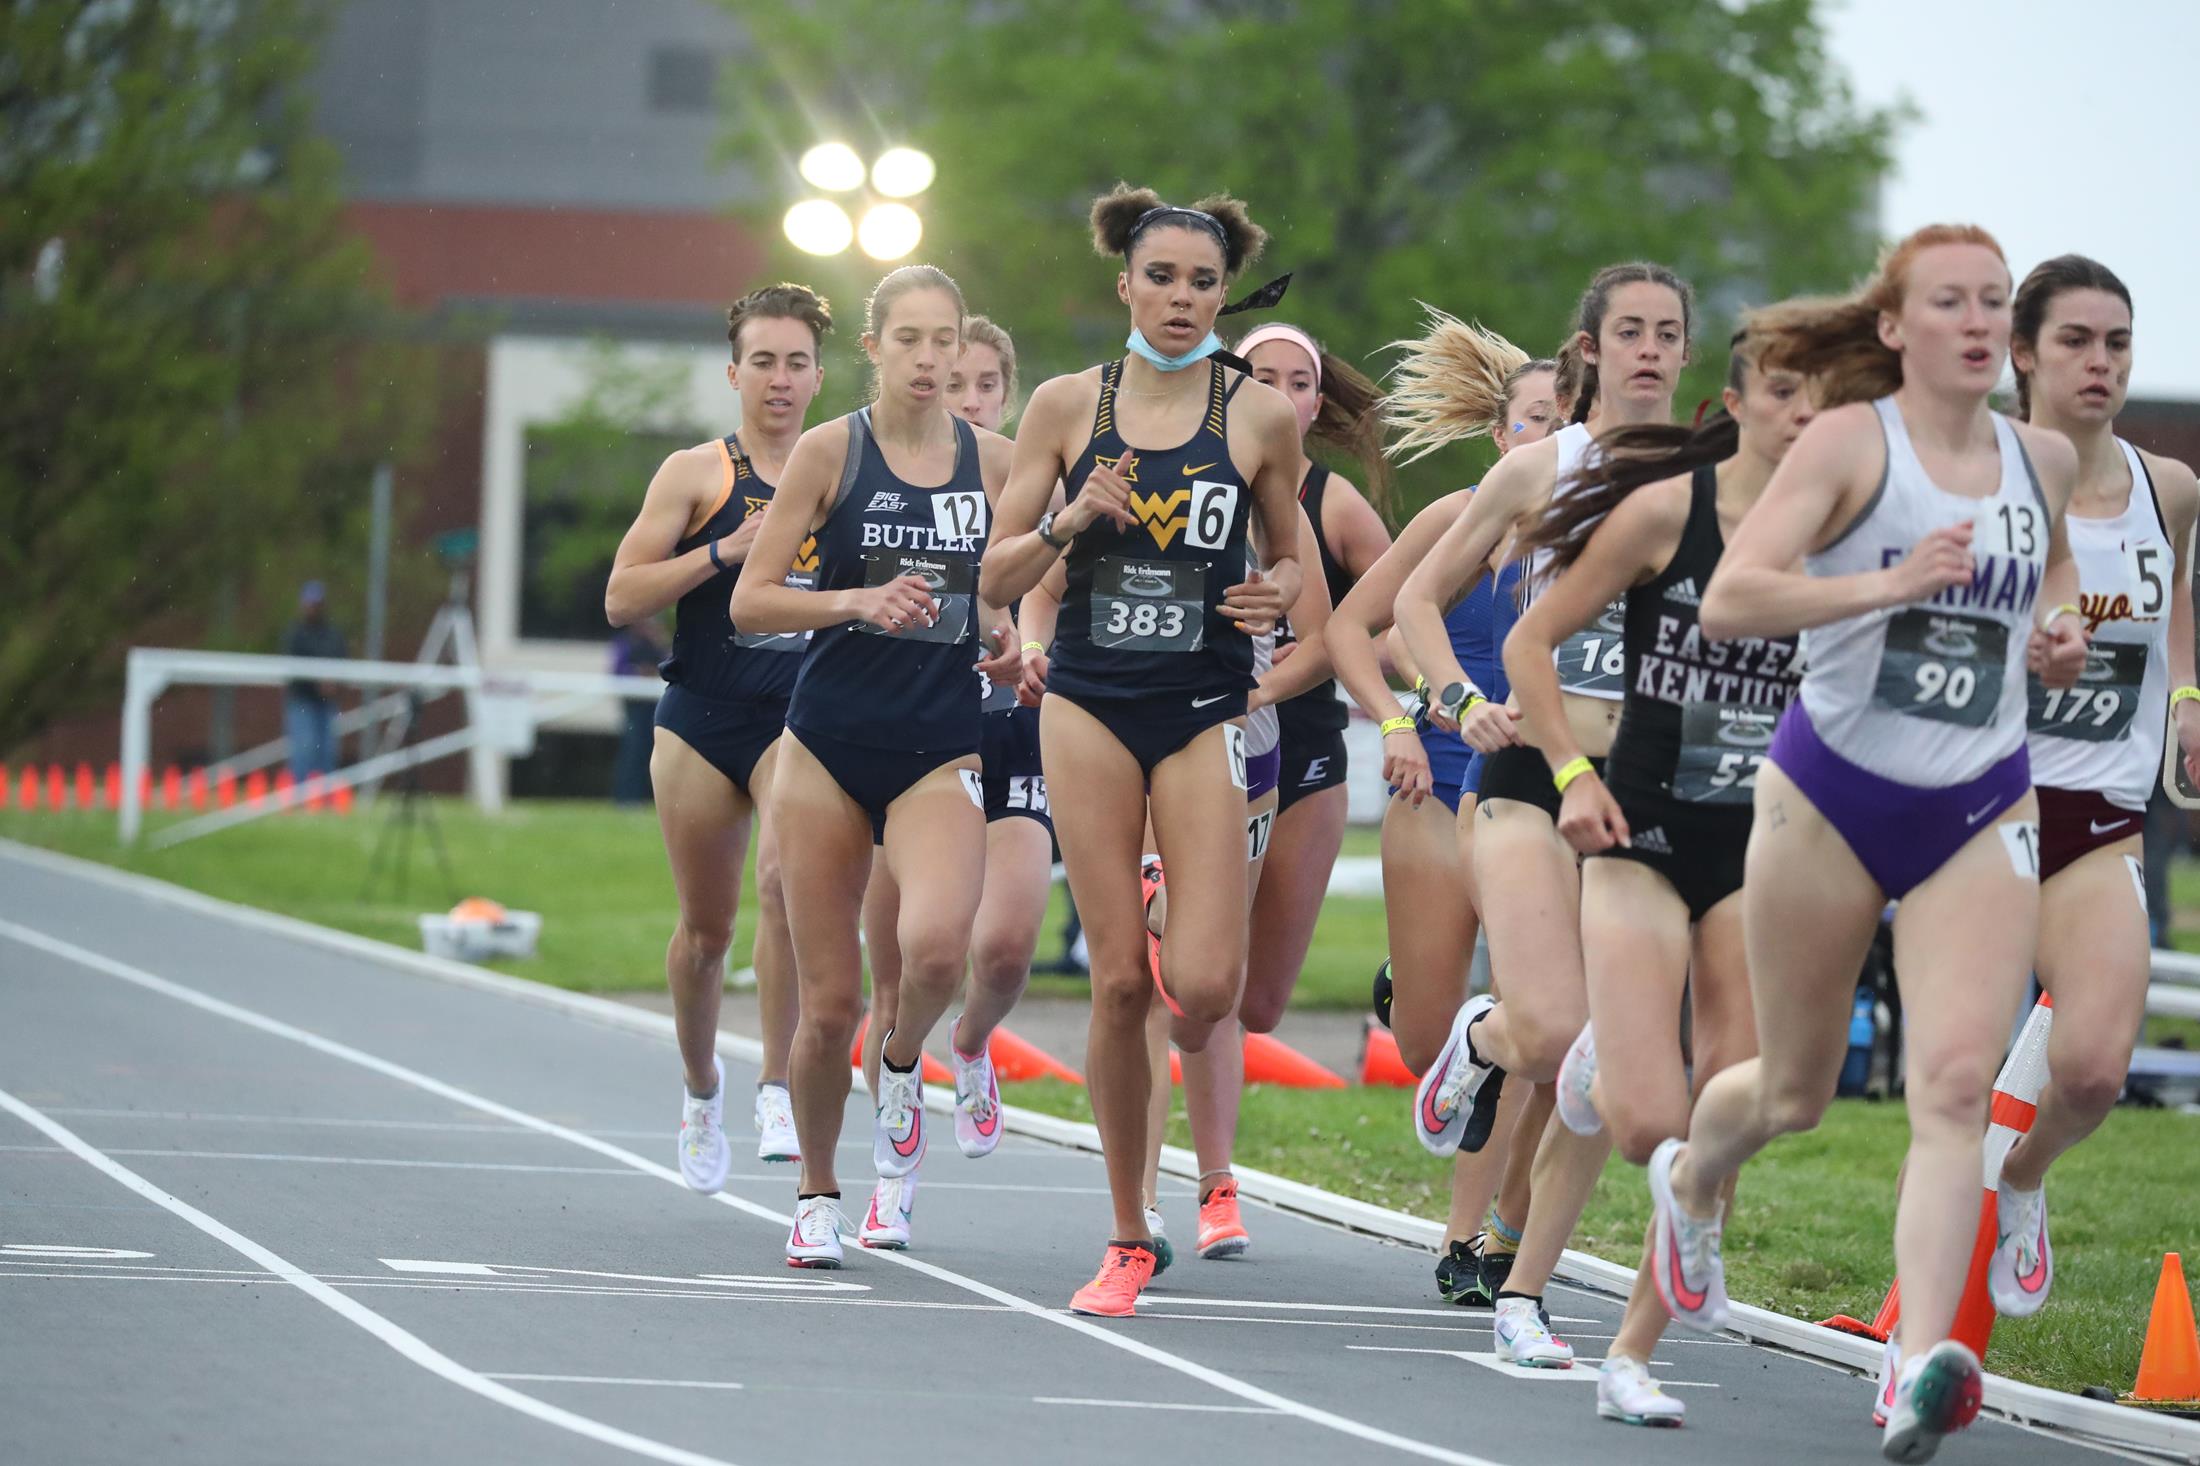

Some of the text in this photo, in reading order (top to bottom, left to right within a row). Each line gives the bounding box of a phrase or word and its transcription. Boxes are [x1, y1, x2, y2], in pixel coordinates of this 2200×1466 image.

[868, 500, 909, 511] EAST
[873, 491, 902, 501] BIG
[943, 494, 980, 536] 12
[1197, 486, 1228, 545] 6
[1998, 504, 2036, 556] 13
[2136, 549, 2164, 613] 5
[1106, 601, 1186, 638] 383
[1654, 615, 1799, 679] EASTE
[1914, 662, 1976, 709] 90
[2042, 687, 2121, 727] 179
[1303, 756, 1330, 781] E
[1247, 812, 1271, 859] 17
